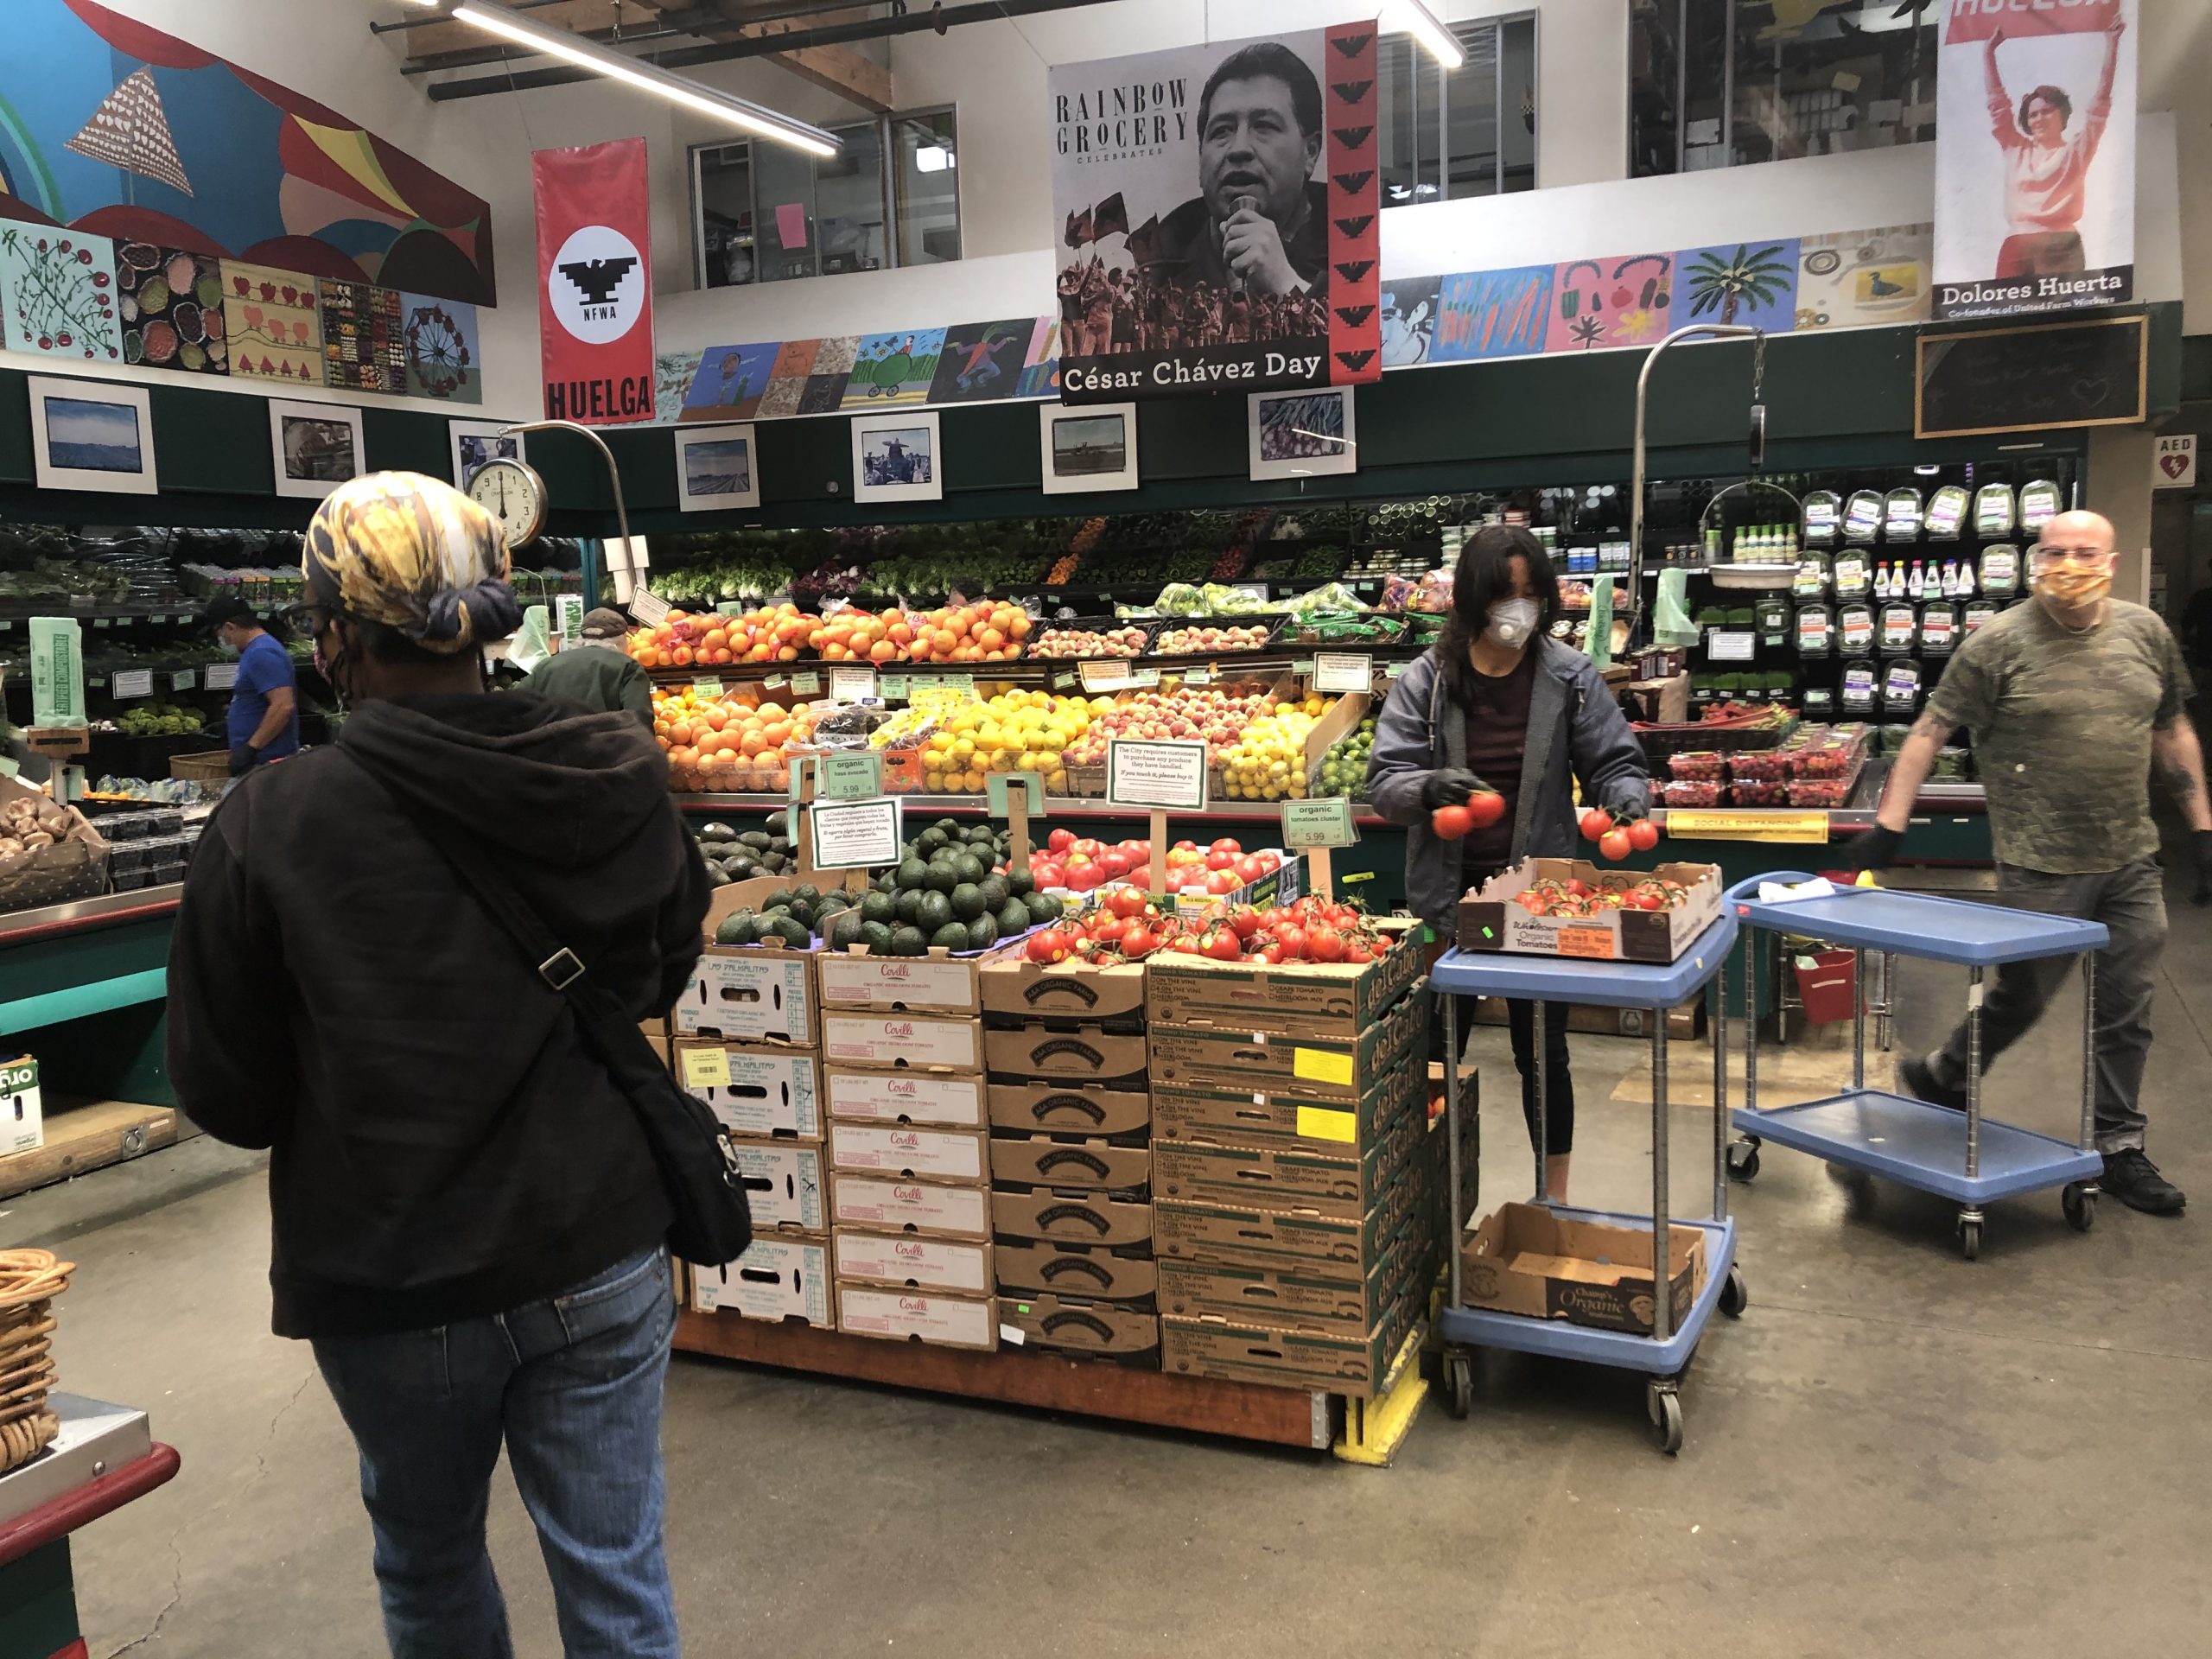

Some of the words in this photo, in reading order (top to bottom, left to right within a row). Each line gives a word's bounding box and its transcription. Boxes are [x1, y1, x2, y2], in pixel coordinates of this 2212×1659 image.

[1056, 79, 1186, 123] RAINBOW
[1058, 111, 1187, 155] GROCERY
[1077, 149, 1162, 164] CELEBRATES
[1942, 283, 2031, 305] Dolores
[2038, 274, 2122, 297] Huerta
[584, 306, 616, 321] NFWA
[2014, 303, 2044, 312] United
[2047, 302, 2071, 310] Farm
[1065, 365, 1142, 391] César
[1153, 357, 1255, 385] Chávez
[1266, 353, 1321, 377] Day
[547, 376, 651, 420] HUELGA
[2161, 439, 2190, 451] AED
[485, 478, 490, 486] 9
[513, 475, 516, 484] 1
[523, 489, 527, 498] 2
[524, 506, 529, 515] 3
[517, 521, 520, 530] 4
[54, 635, 69, 683] COMPOSTABLE
[1306, 832, 1325, 841] 5.99
[1519, 931, 1554, 940] Organic
[1516, 939, 1557, 949] Tomatoes
[880, 963, 910, 976] Covilli
[885, 1021, 914, 1036] Covilli
[888, 1080, 918, 1094] Covilli
[891, 1132, 920, 1147] Covilli
[893, 1186, 924, 1200] Covilli
[895, 1242, 924, 1257] Covilli
[899, 1298, 928, 1312] Covilli
[1560, 1289, 1624, 1313] Organic
